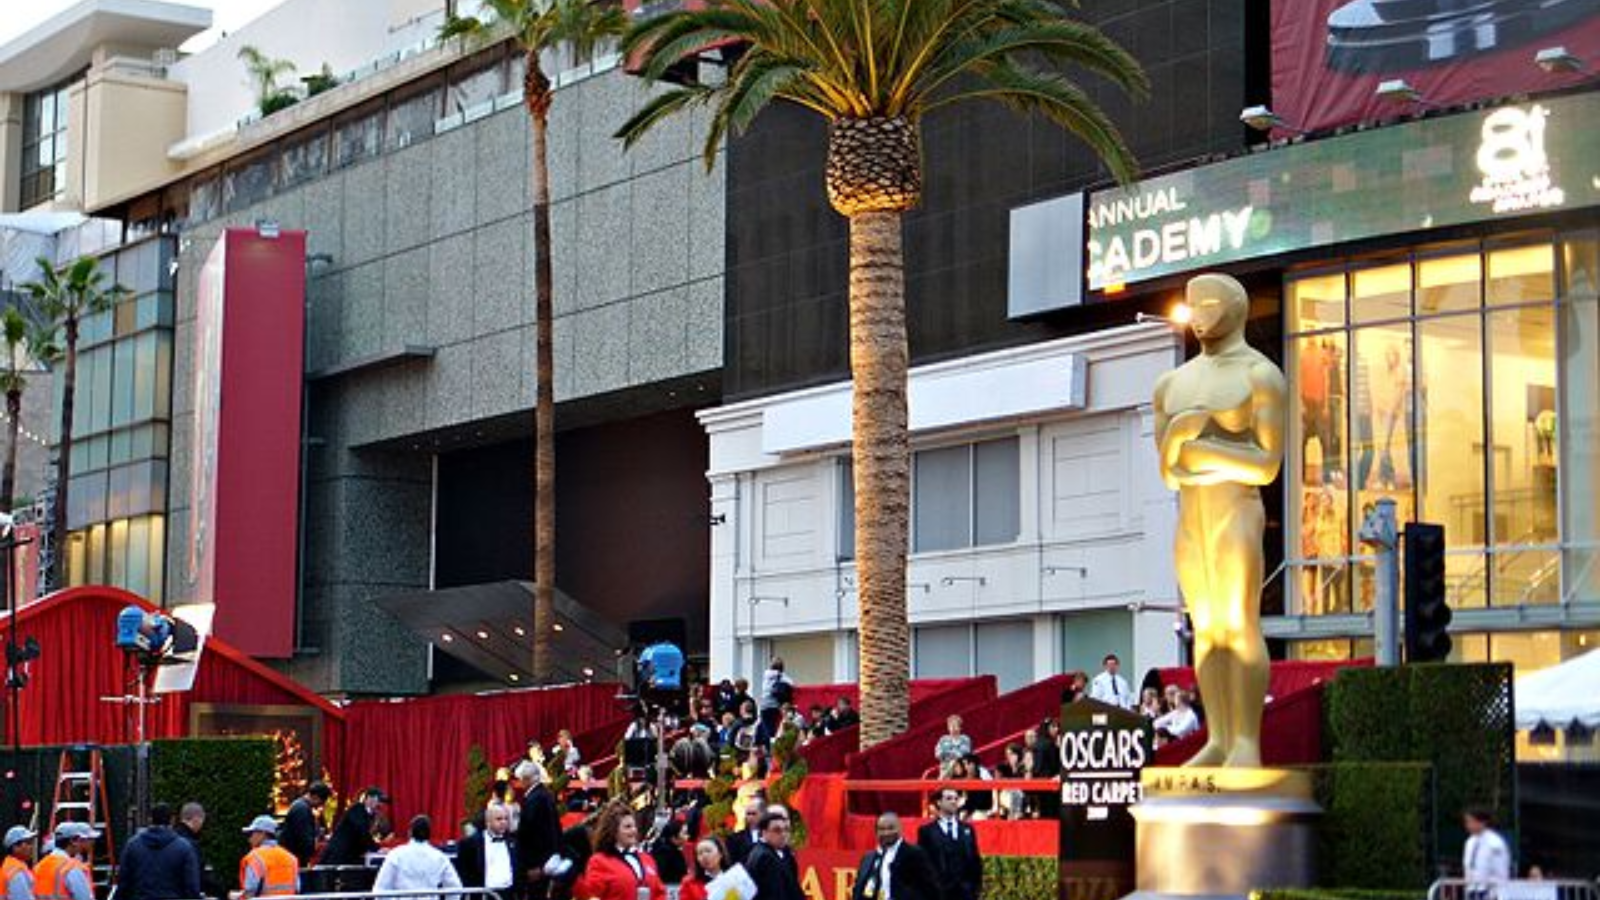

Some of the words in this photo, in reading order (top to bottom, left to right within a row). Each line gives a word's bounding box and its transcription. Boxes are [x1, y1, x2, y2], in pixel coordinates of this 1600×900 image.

[1061, 729, 1145, 770] OSCARS
[1062, 782, 1089, 804] RED
[1092, 781, 1143, 803] CARPET
